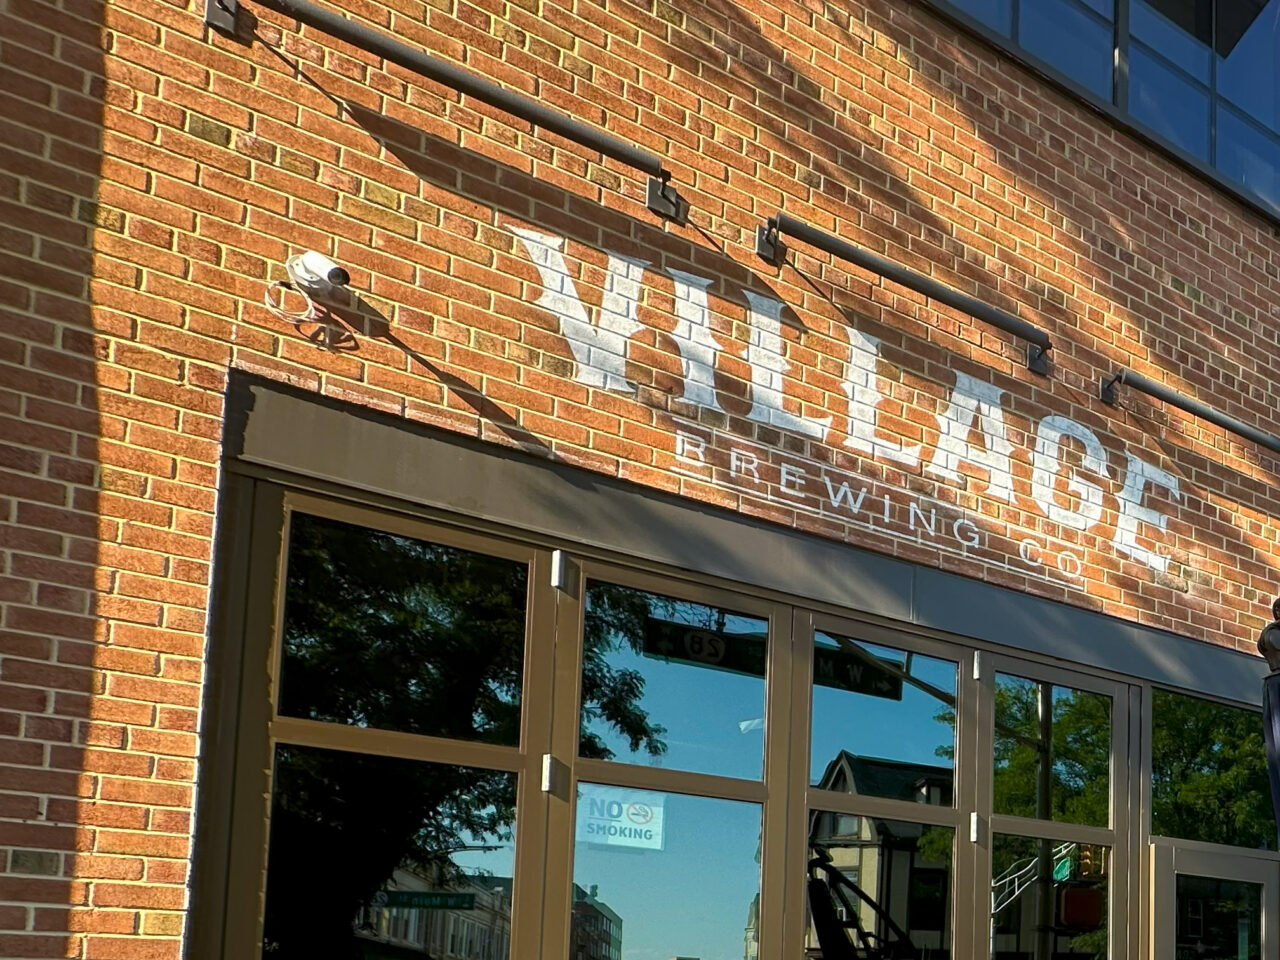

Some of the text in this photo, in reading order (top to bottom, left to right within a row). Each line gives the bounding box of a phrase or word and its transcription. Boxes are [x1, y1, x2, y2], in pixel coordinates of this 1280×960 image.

[504, 223, 1181, 573] VILLAGE
[675, 429, 979, 549] BREWING
[587, 822, 653, 841] SMOKING
[589, 798, 623, 818] NO
